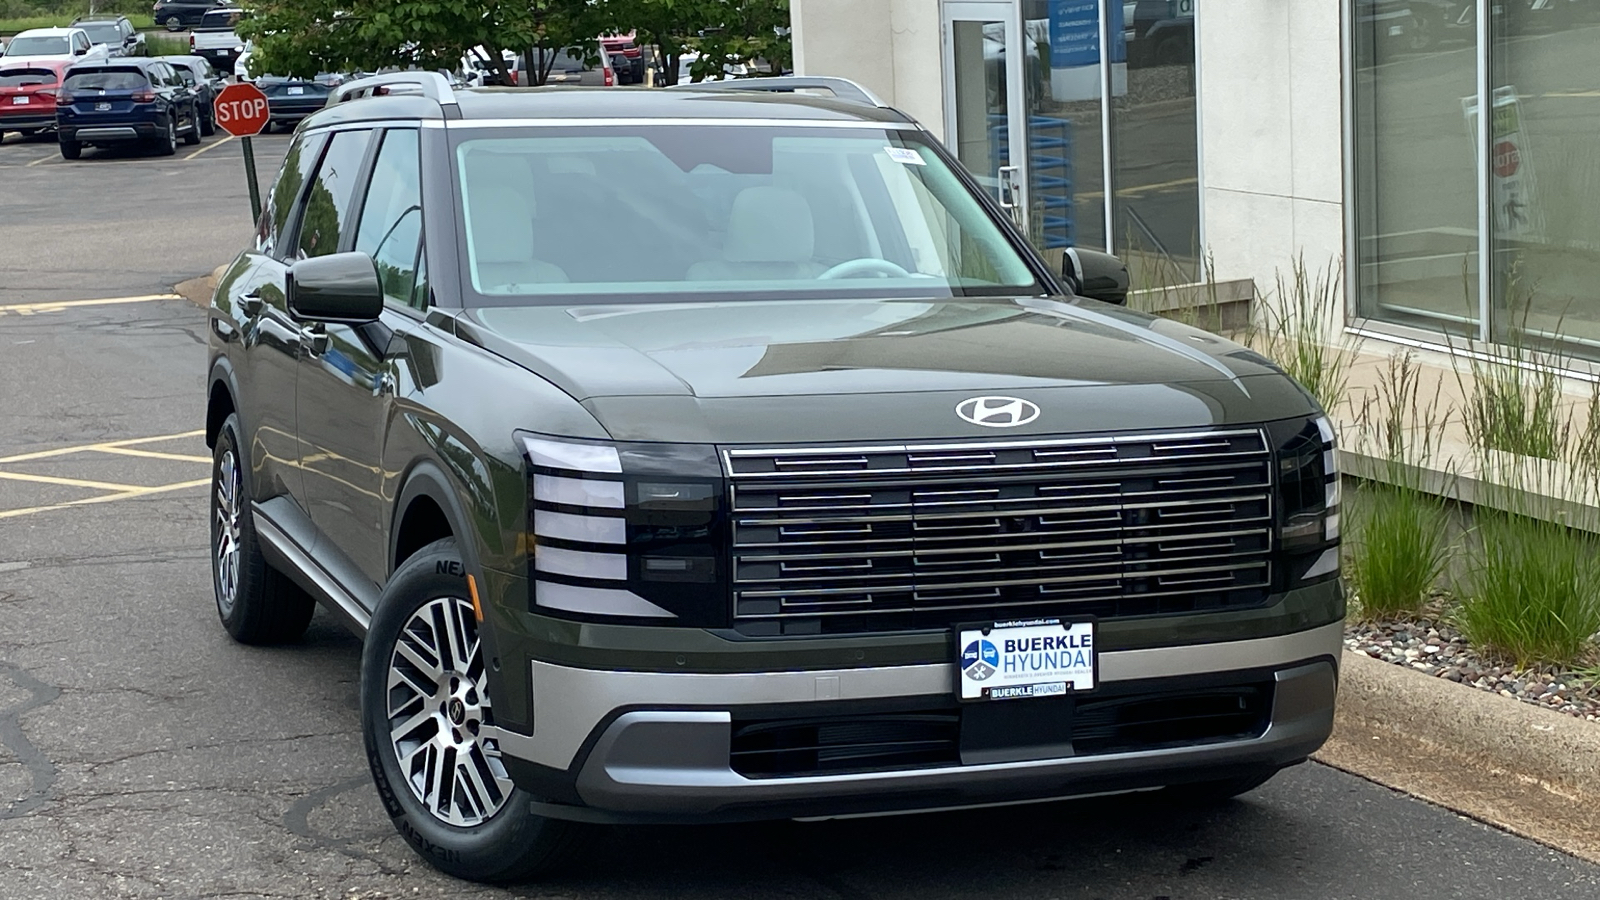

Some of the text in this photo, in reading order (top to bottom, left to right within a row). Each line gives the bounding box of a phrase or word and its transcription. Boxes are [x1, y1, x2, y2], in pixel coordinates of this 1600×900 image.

[218, 98, 265, 122] STOP
[994, 619, 1060, 628] buerklehyundai.com
[1004, 634, 1092, 653] BUERKLE
[1004, 650, 1092, 673] HYUNDAI
[991, 683, 1065, 698] BUERKLE HYUNDAI
[402, 819, 461, 862] NEXEN
